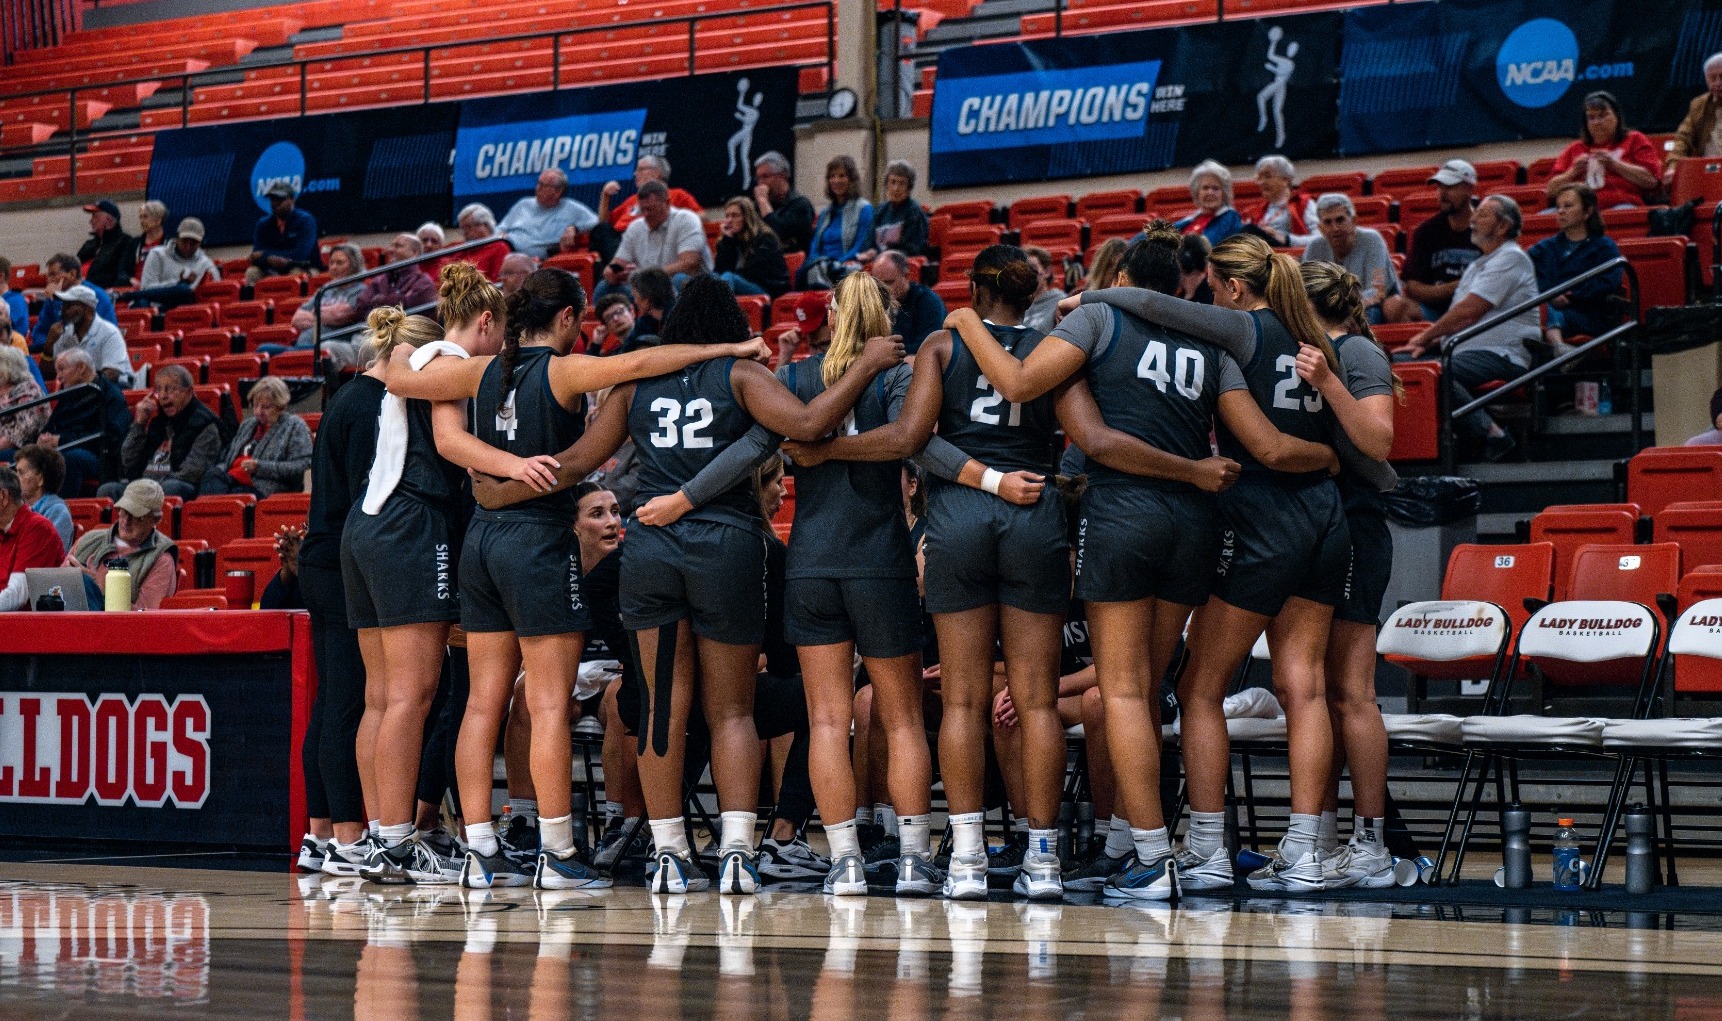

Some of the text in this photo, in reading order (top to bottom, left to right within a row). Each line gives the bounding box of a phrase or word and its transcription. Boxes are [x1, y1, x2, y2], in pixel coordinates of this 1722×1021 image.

[1504, 58, 1575, 87] NCAA
[957, 82, 1150, 135] CHAMPIONS
[1150, 98, 1186, 113] HERE
[475, 129, 637, 180] CHAMPIONS
[1137, 340, 1205, 401] 40
[495, 388, 519, 441] 4
[650, 397, 714, 449] 32
[435, 543, 450, 600] SHARKS
[1075, 518, 1088, 576] SHARKS
[1497, 557, 1511, 567] 36
[569, 554, 583, 611] SHARKS
[1395, 616, 1494, 629] LADY BULLDOG
[1539, 617, 1643, 630] LADY BULLDOG
